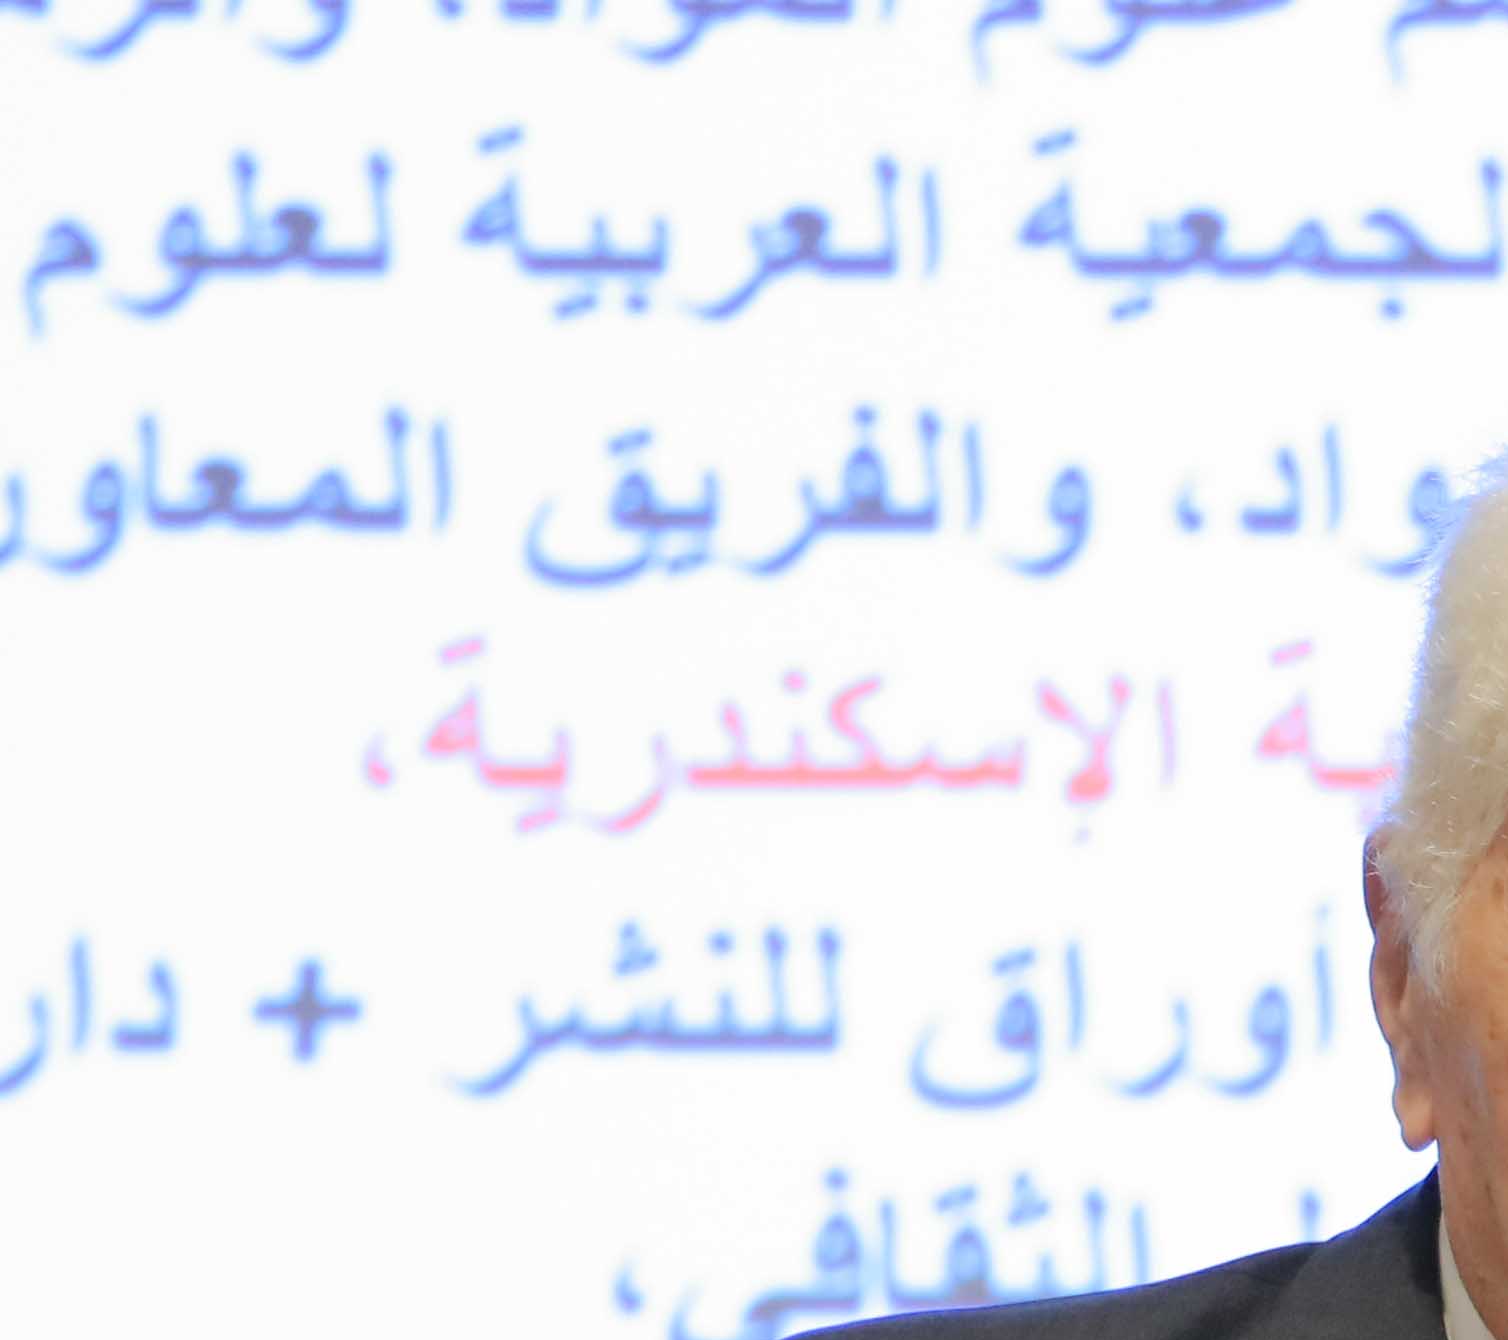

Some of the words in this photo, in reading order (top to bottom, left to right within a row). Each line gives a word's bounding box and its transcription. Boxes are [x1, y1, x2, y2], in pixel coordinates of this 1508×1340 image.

[24, 149, 395, 334] لعلوم
[460, 125, 942, 323] العربية
[523, 404, 1094, 590] والفريق
[450, 921, 843, 1098] للنشر
[908, 905, 1334, 1110] أوراق
